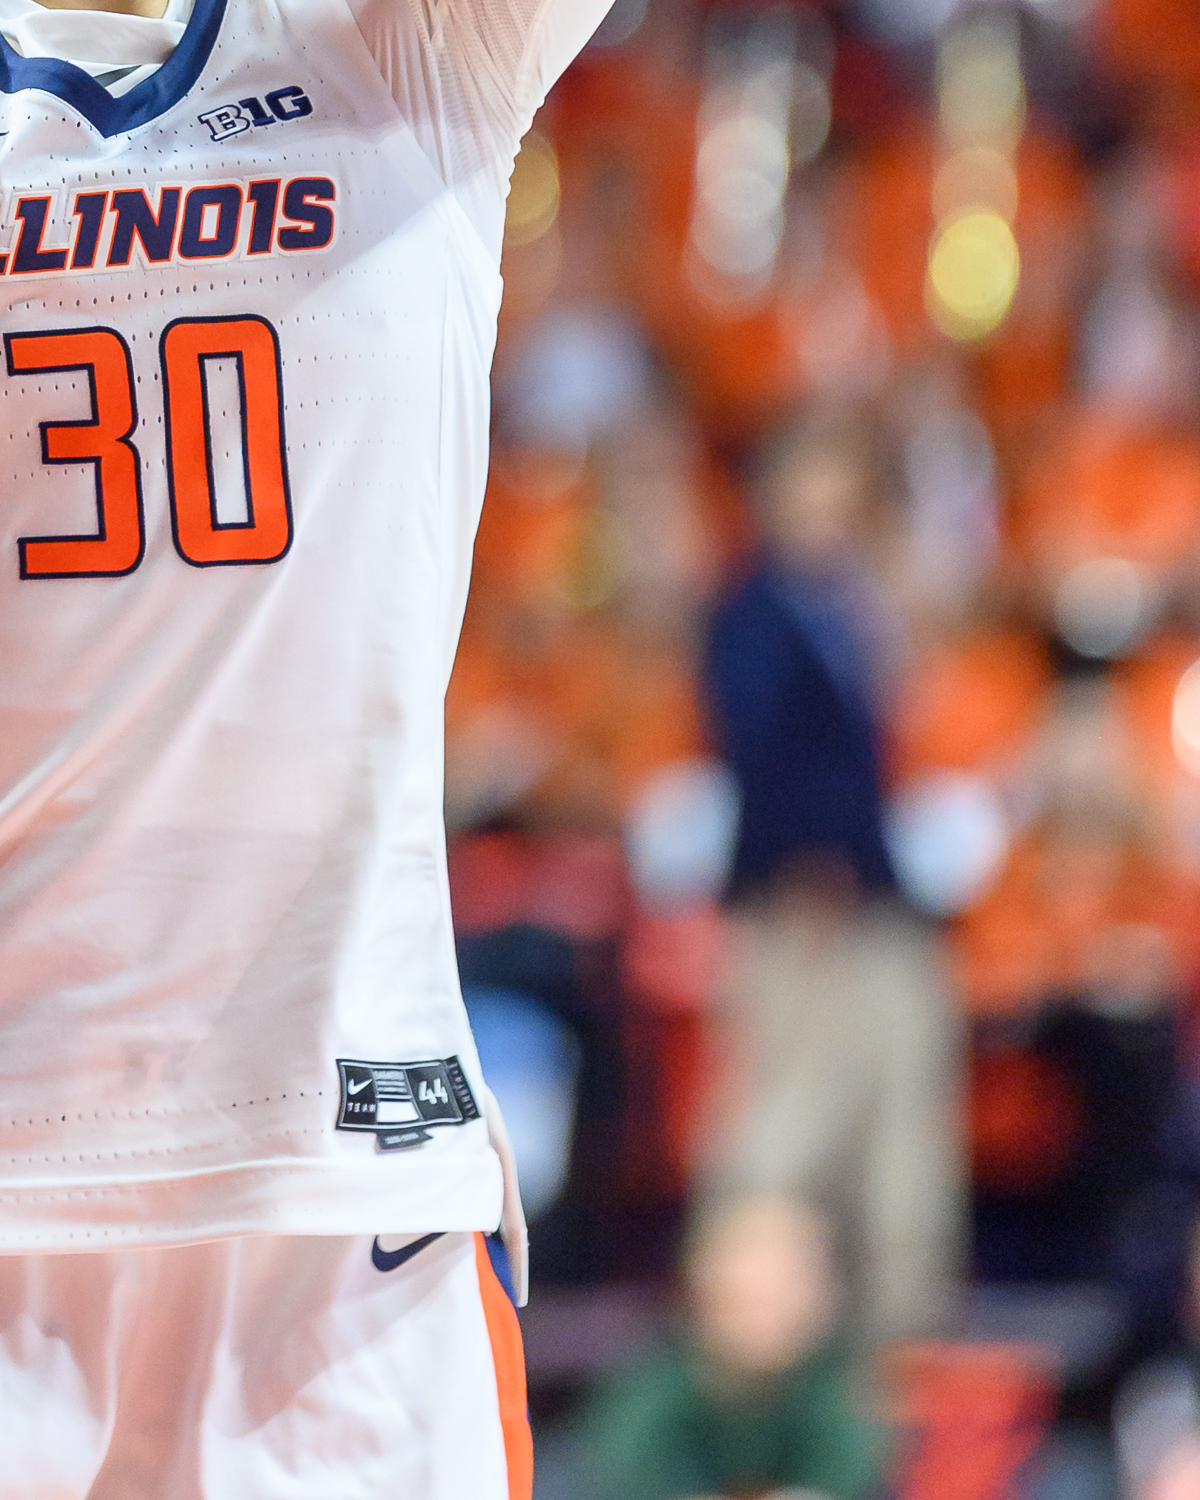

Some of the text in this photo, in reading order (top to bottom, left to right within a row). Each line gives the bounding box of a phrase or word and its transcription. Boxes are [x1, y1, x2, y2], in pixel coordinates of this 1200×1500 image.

[3, 313, 294, 580] 30
[418, 1077, 449, 1105] 44
[347, 1101, 377, 1114] TEAM
